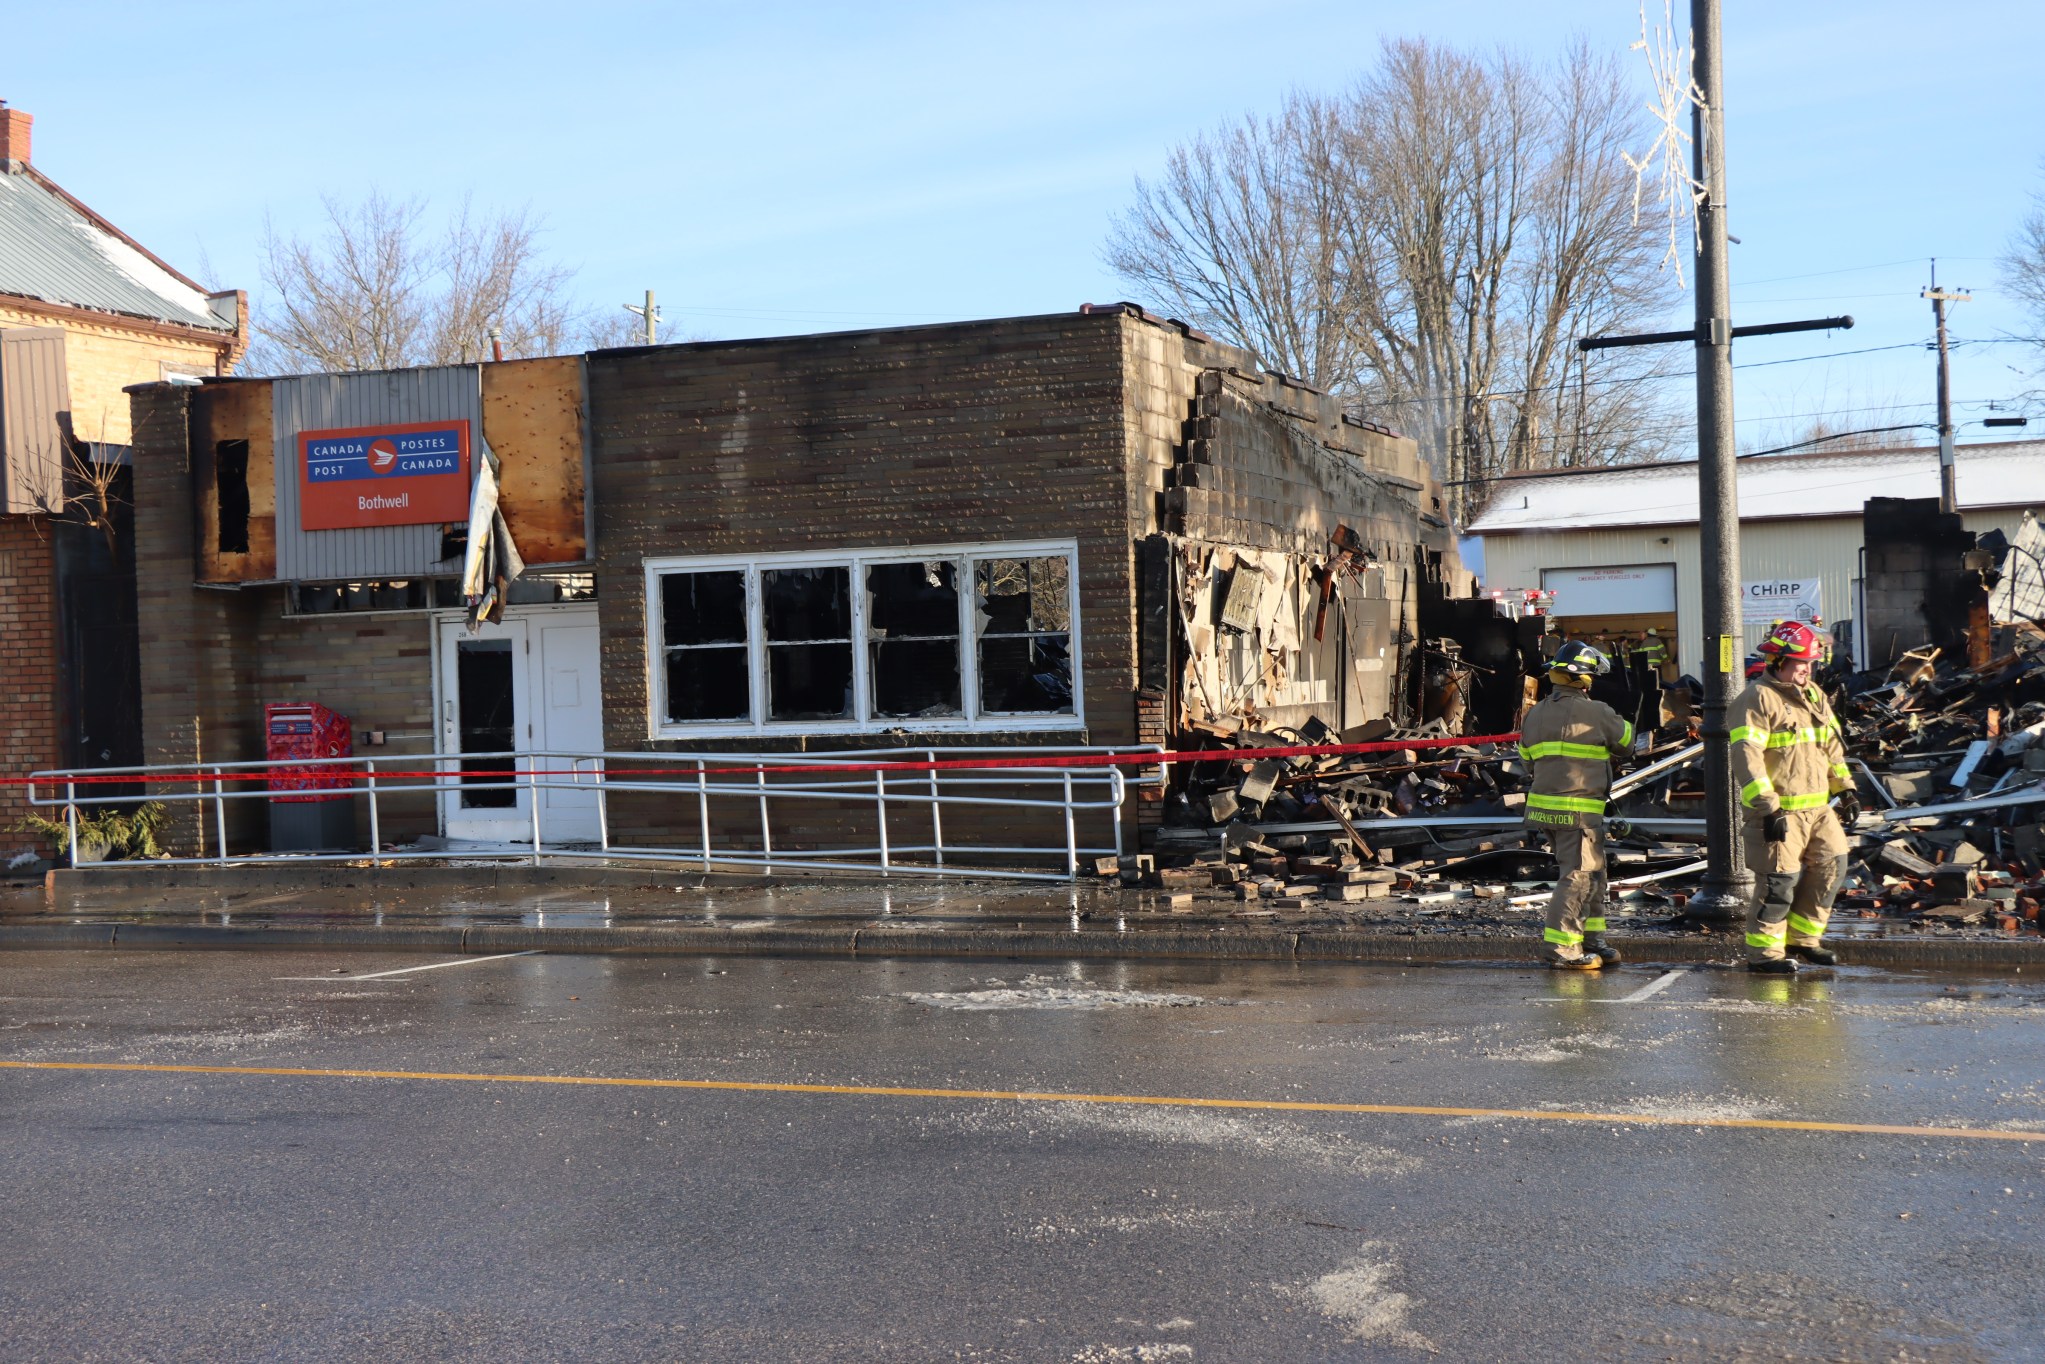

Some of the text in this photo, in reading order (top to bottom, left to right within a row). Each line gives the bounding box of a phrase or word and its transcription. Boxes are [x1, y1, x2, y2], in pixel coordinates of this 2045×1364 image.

[313, 444, 364, 456] CANADA
[401, 438, 446, 450] POSTES
[401, 458, 452, 470] CANADA
[314, 465, 344, 476] POST
[358, 492, 409, 511] Bothwell
